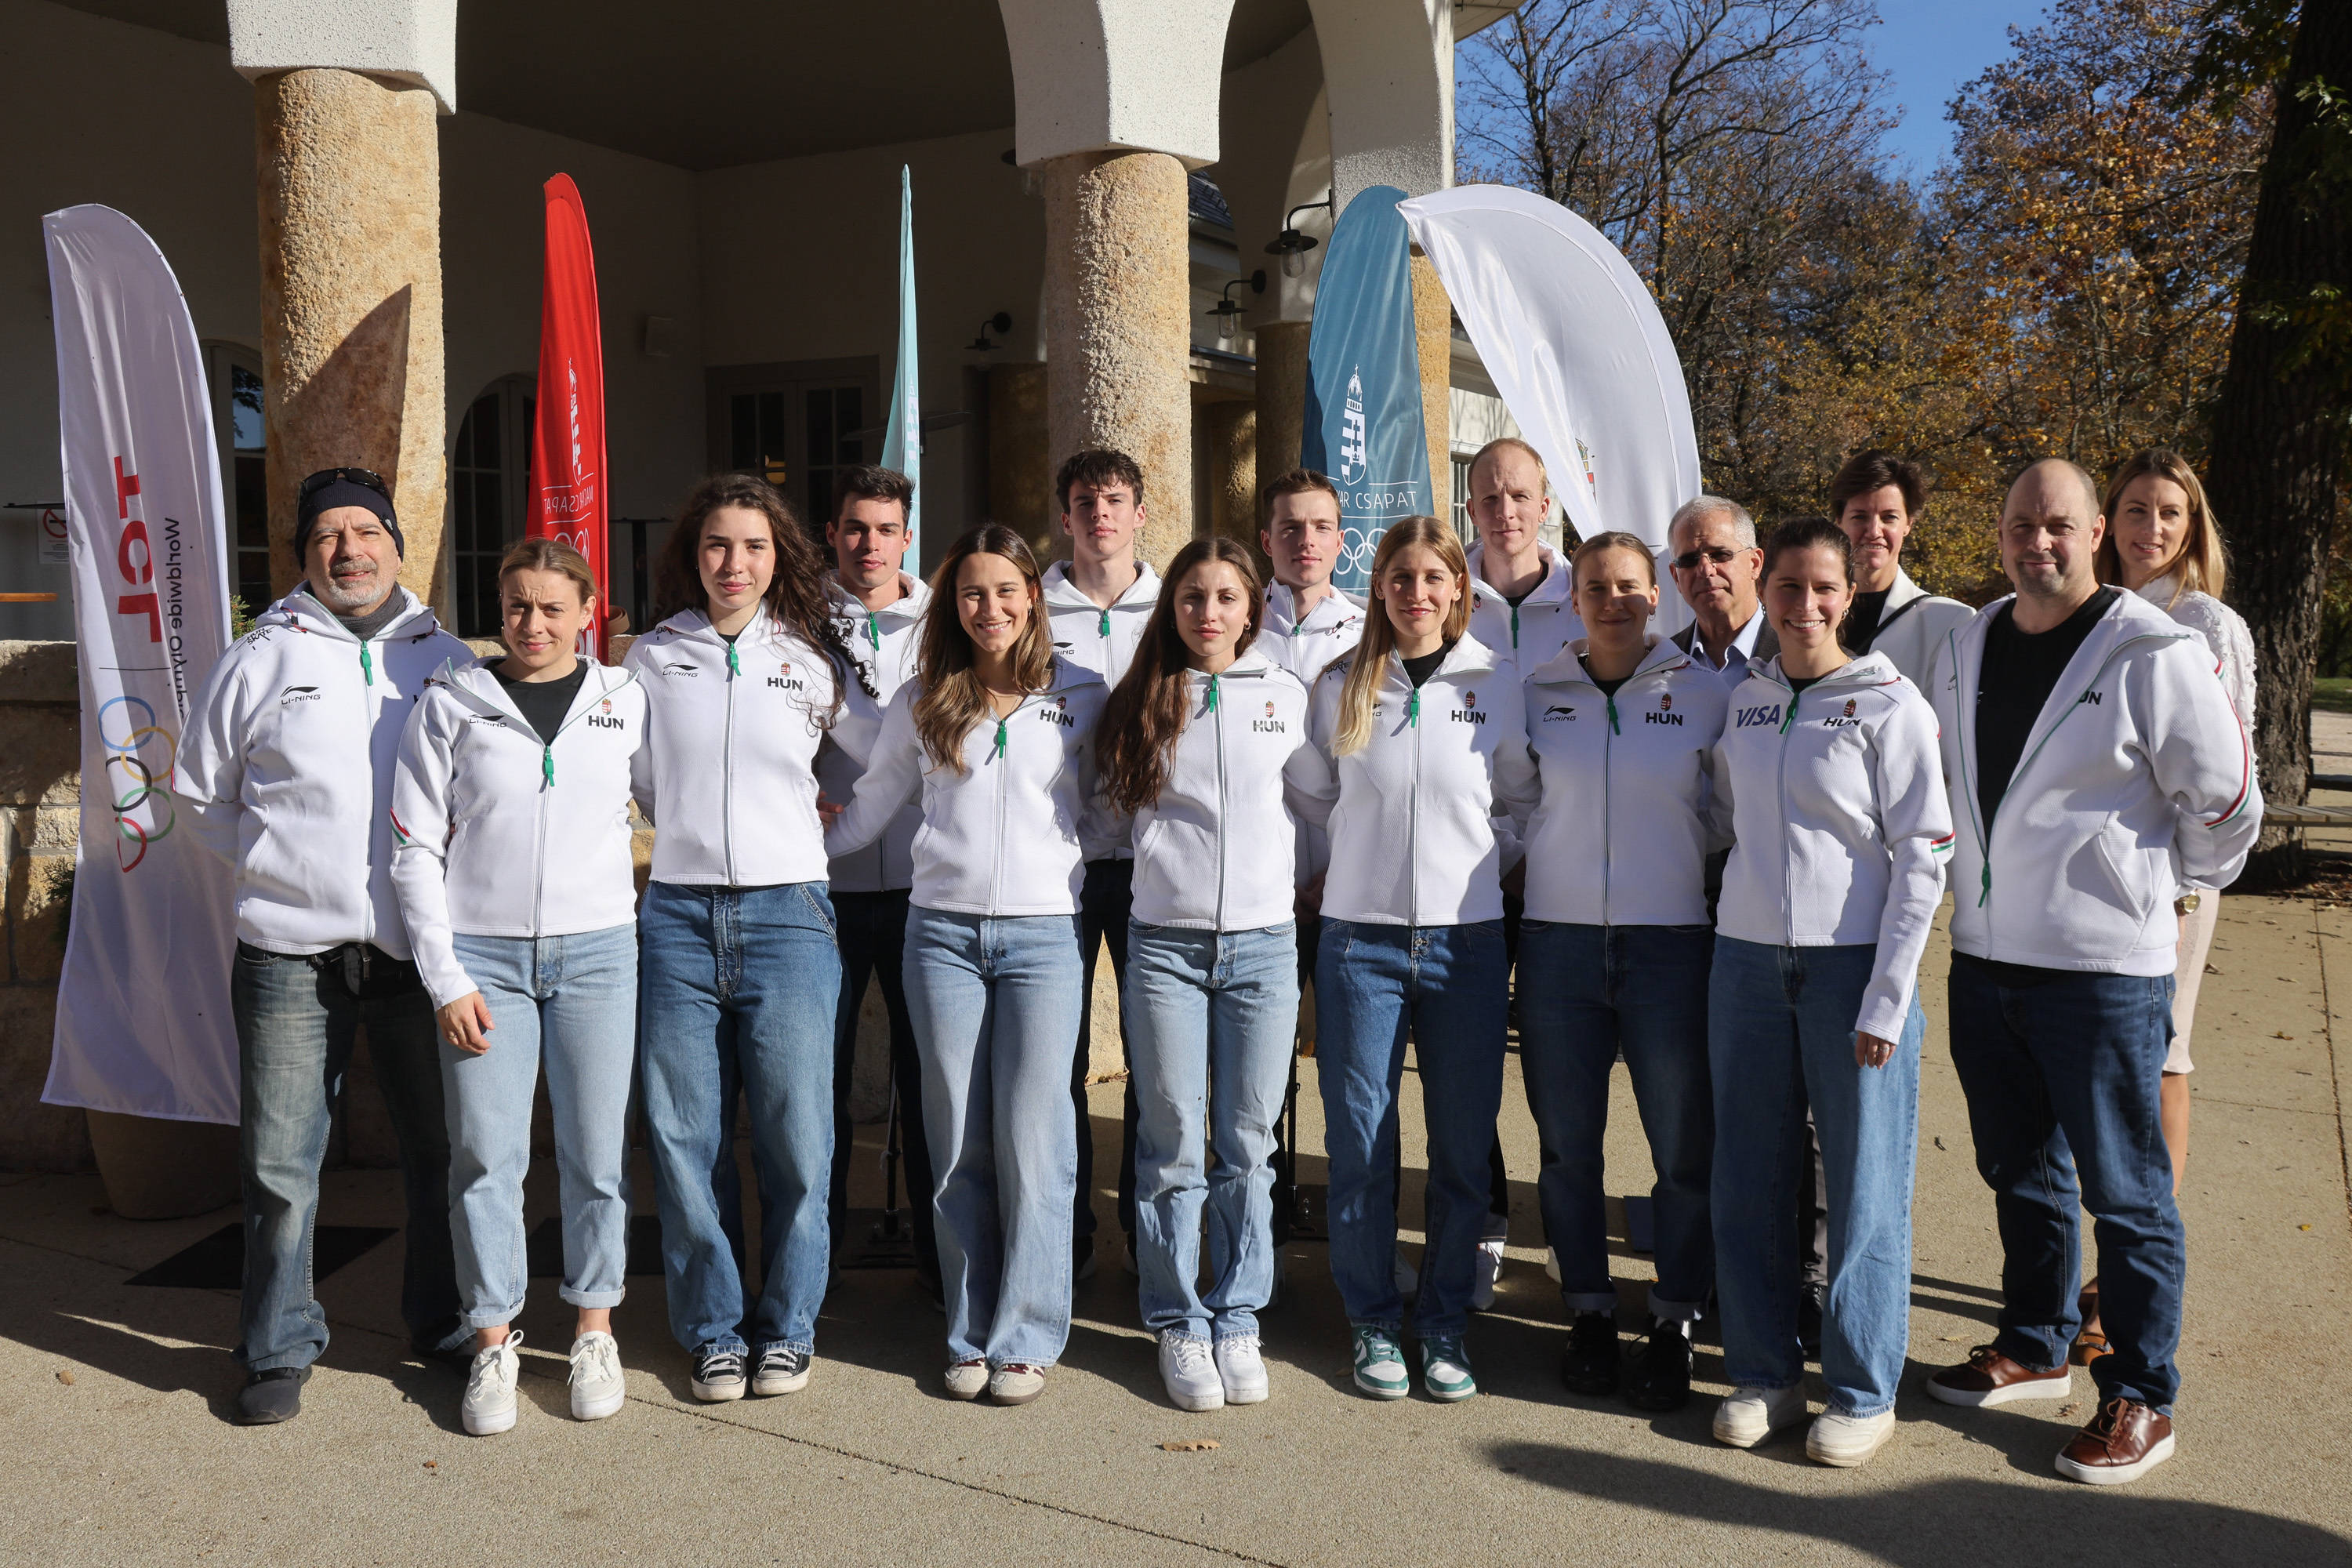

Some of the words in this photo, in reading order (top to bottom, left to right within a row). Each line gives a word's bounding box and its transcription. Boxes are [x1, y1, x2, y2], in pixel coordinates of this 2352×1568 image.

[1356, 491, 1417, 509] CSAPAT
[768, 677, 803, 691] HUN
[281, 694, 321, 705] LI-NING
[588, 715, 624, 730] HUN
[1040, 709, 1074, 728] HUN
[1451, 710, 1486, 724] HUN
[1646, 712, 1683, 726] HUN
[1736, 704, 1780, 728] VISA
[1823, 717, 1862, 727] HUN
[1253, 720, 1285, 734] HUN
